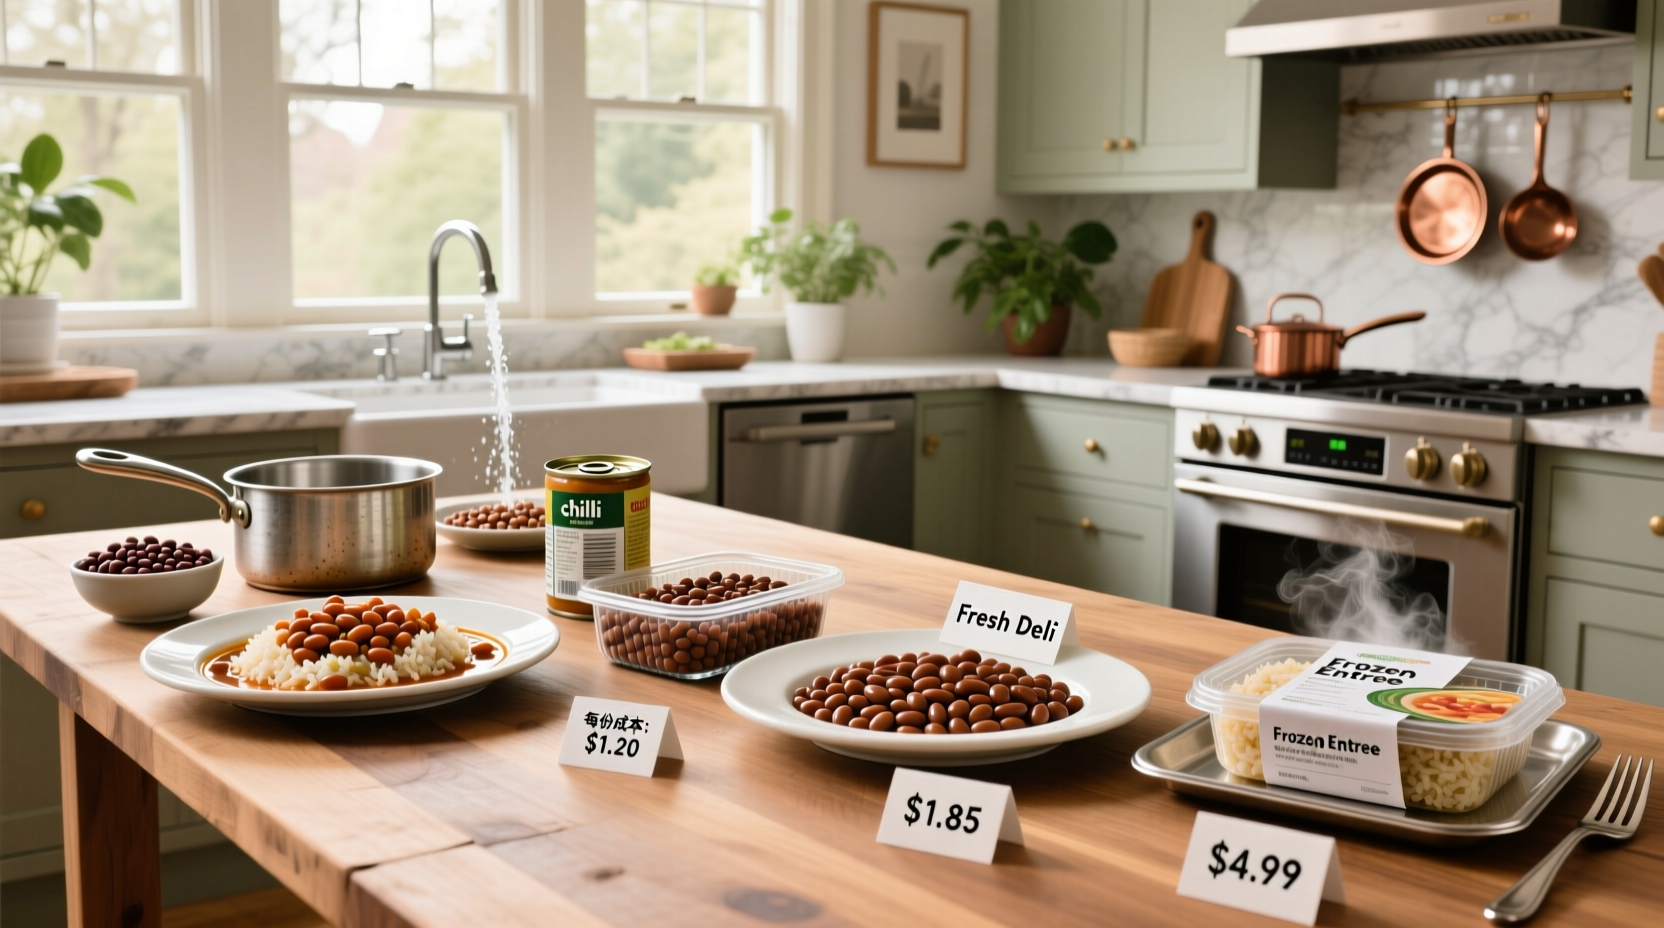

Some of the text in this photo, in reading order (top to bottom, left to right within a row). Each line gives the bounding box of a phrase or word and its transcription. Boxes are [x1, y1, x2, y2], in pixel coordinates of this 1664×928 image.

[560, 499, 602, 518] chilli
[956, 603, 1060, 642] Fresh Deli
[1315, 666, 1404, 686] Entree
[1327, 657, 1417, 679] Frozen
[584, 731, 640, 758] $1.20
[1273, 726, 1325, 749] Frozen
[1327, 734, 1381, 756] Entree
[904, 791, 982, 834] $1.85
[1208, 840, 1302, 890] $4.99
